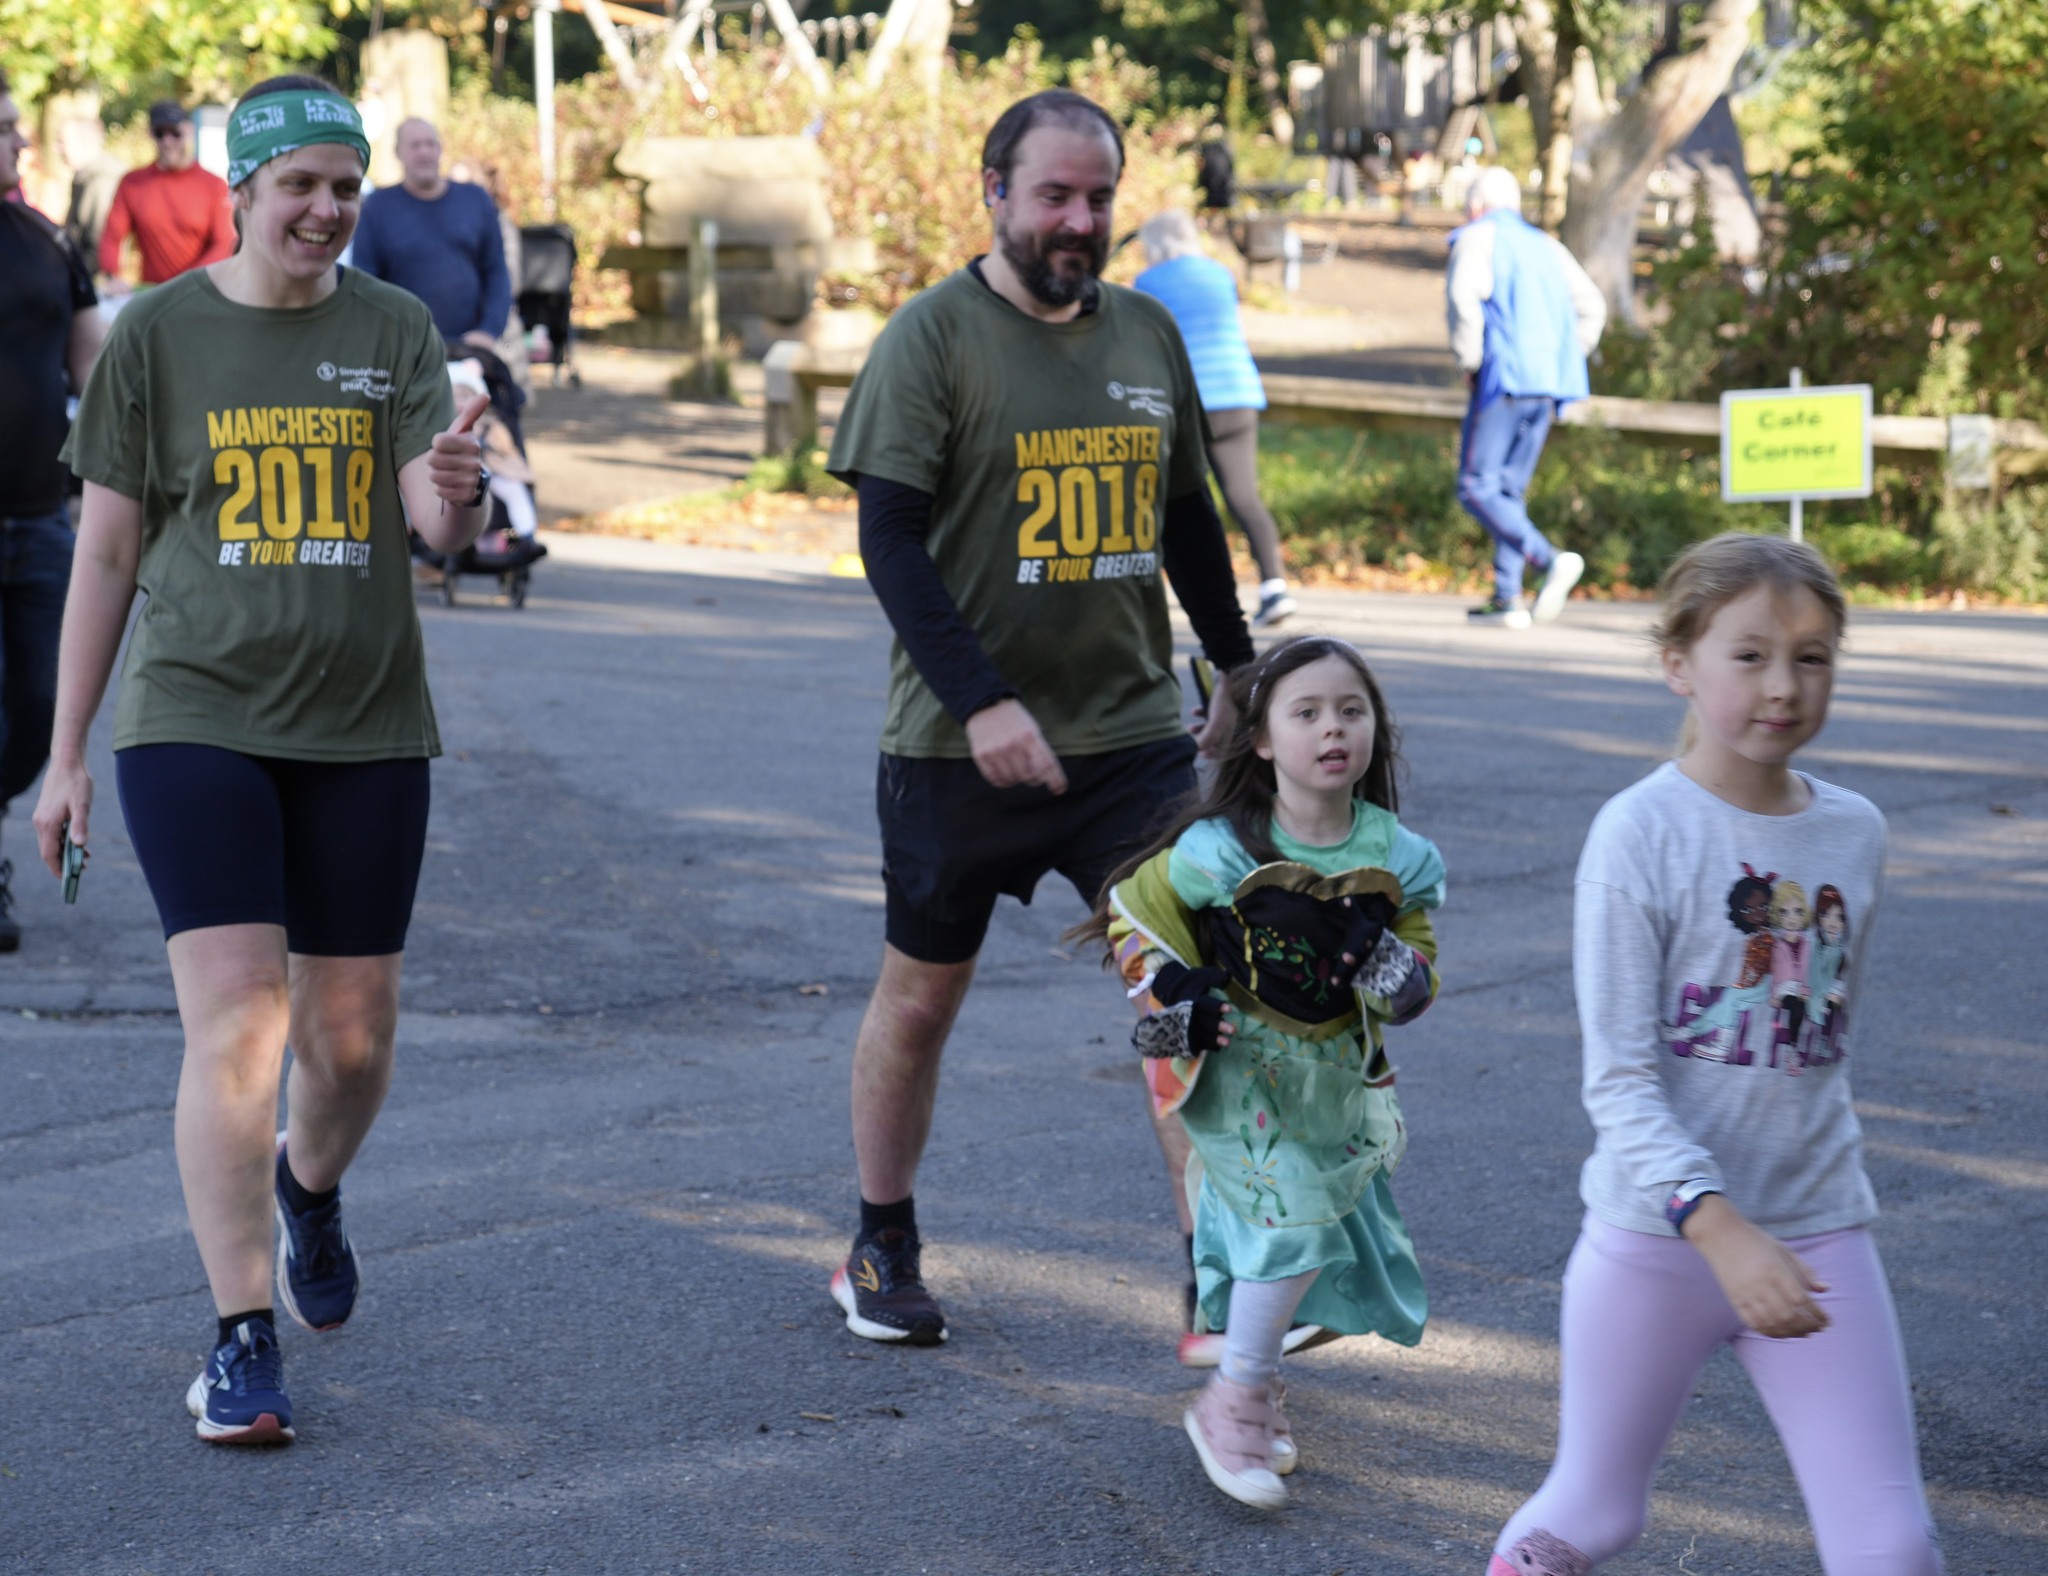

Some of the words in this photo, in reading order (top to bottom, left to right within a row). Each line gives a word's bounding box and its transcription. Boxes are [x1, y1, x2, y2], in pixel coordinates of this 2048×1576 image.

[207, 406, 374, 449] MANCHESTER
[1015, 425, 1161, 469] MANCHESTER
[1743, 441, 1838, 463] Corner
[213, 446, 374, 541] 2018
[1016, 463, 1159, 558] 2018
[218, 539, 245, 566] BE
[250, 540, 296, 565] YOUR
[299, 539, 372, 567] GREATEST
[1017, 559, 1043, 584] BE
[1046, 557, 1092, 582] YOUR
[1093, 552, 1157, 580] GREATEST
